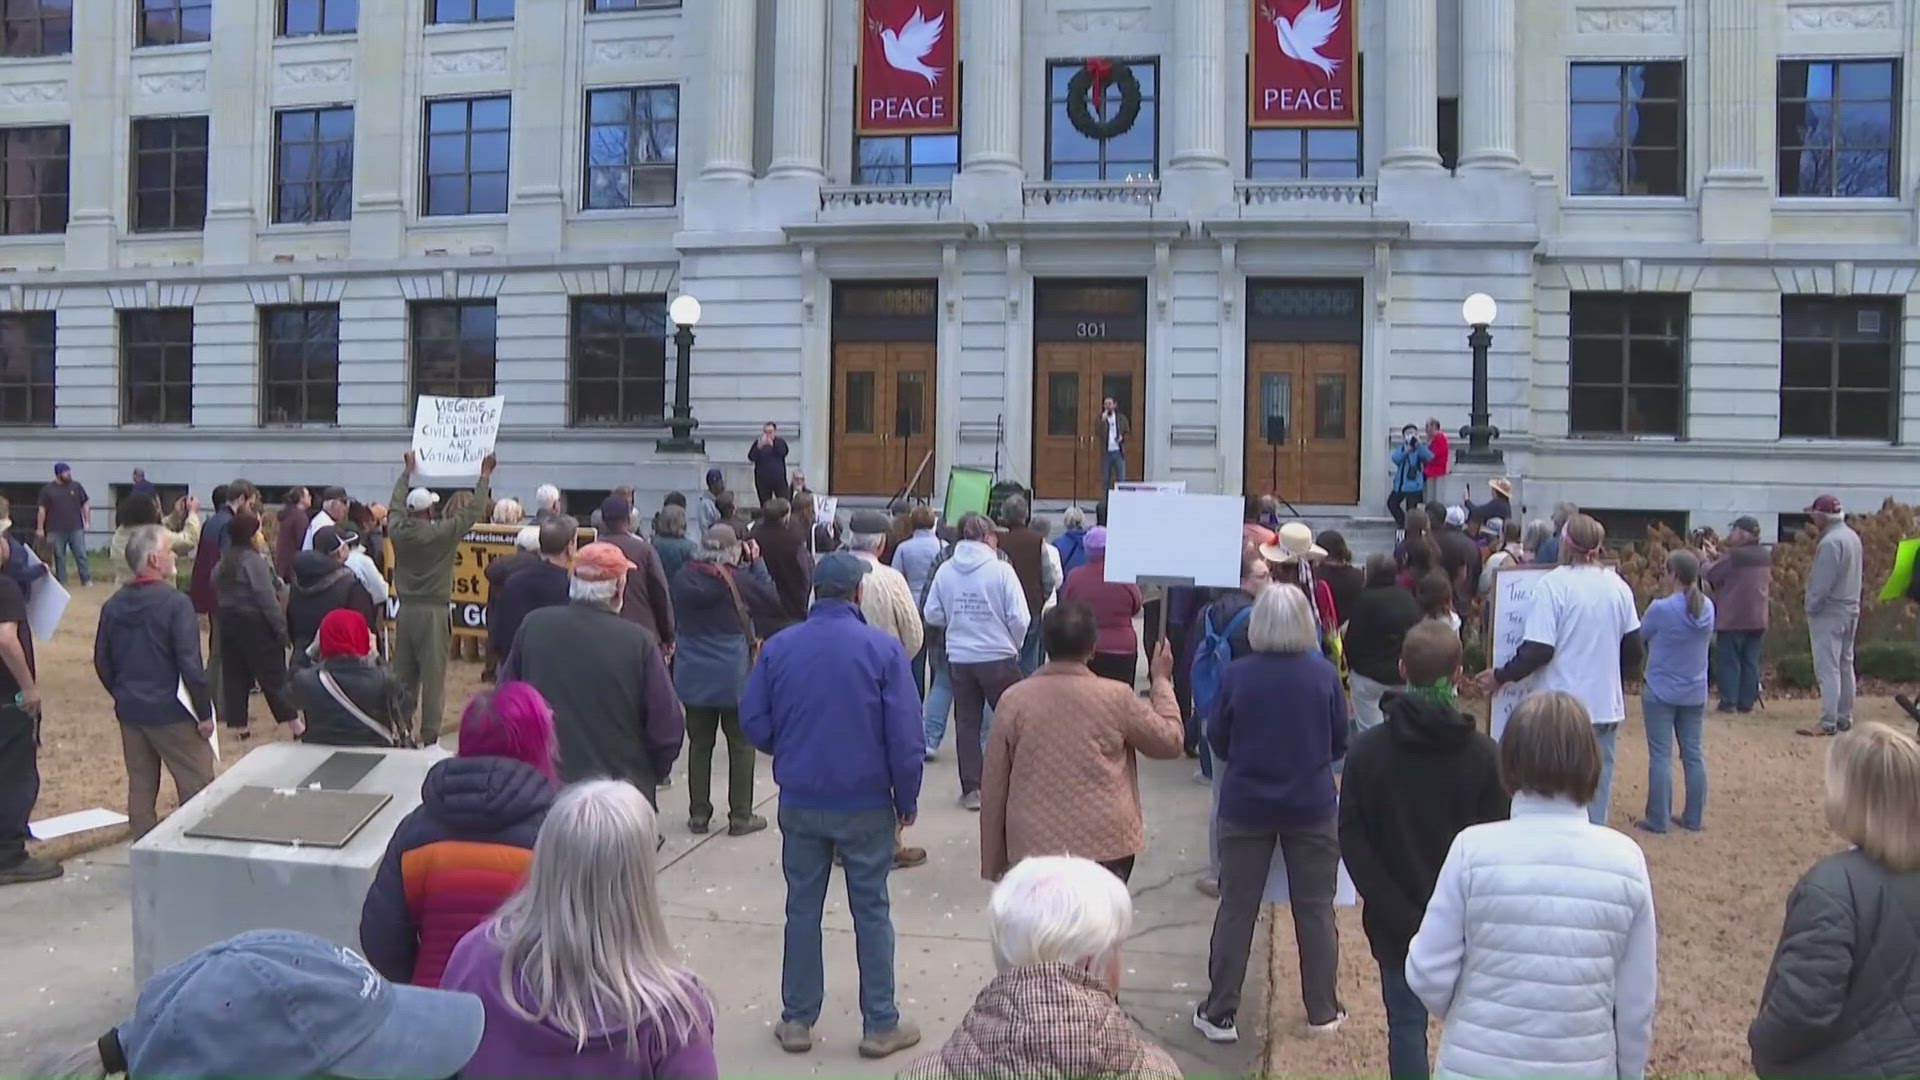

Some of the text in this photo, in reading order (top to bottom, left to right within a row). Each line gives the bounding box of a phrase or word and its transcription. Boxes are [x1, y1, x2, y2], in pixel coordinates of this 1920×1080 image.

[1263, 87, 1345, 111] PEACE
[870, 96, 945, 120] PEACE
[1076, 322, 1106, 337] 301
[435, 398, 453, 412] WE
[436, 408, 496, 425] EROSION OF
[421, 424, 496, 439] CIVIL LIBERTIES
[448, 439, 473, 450] AND
[419, 446, 460, 464] VOTING
